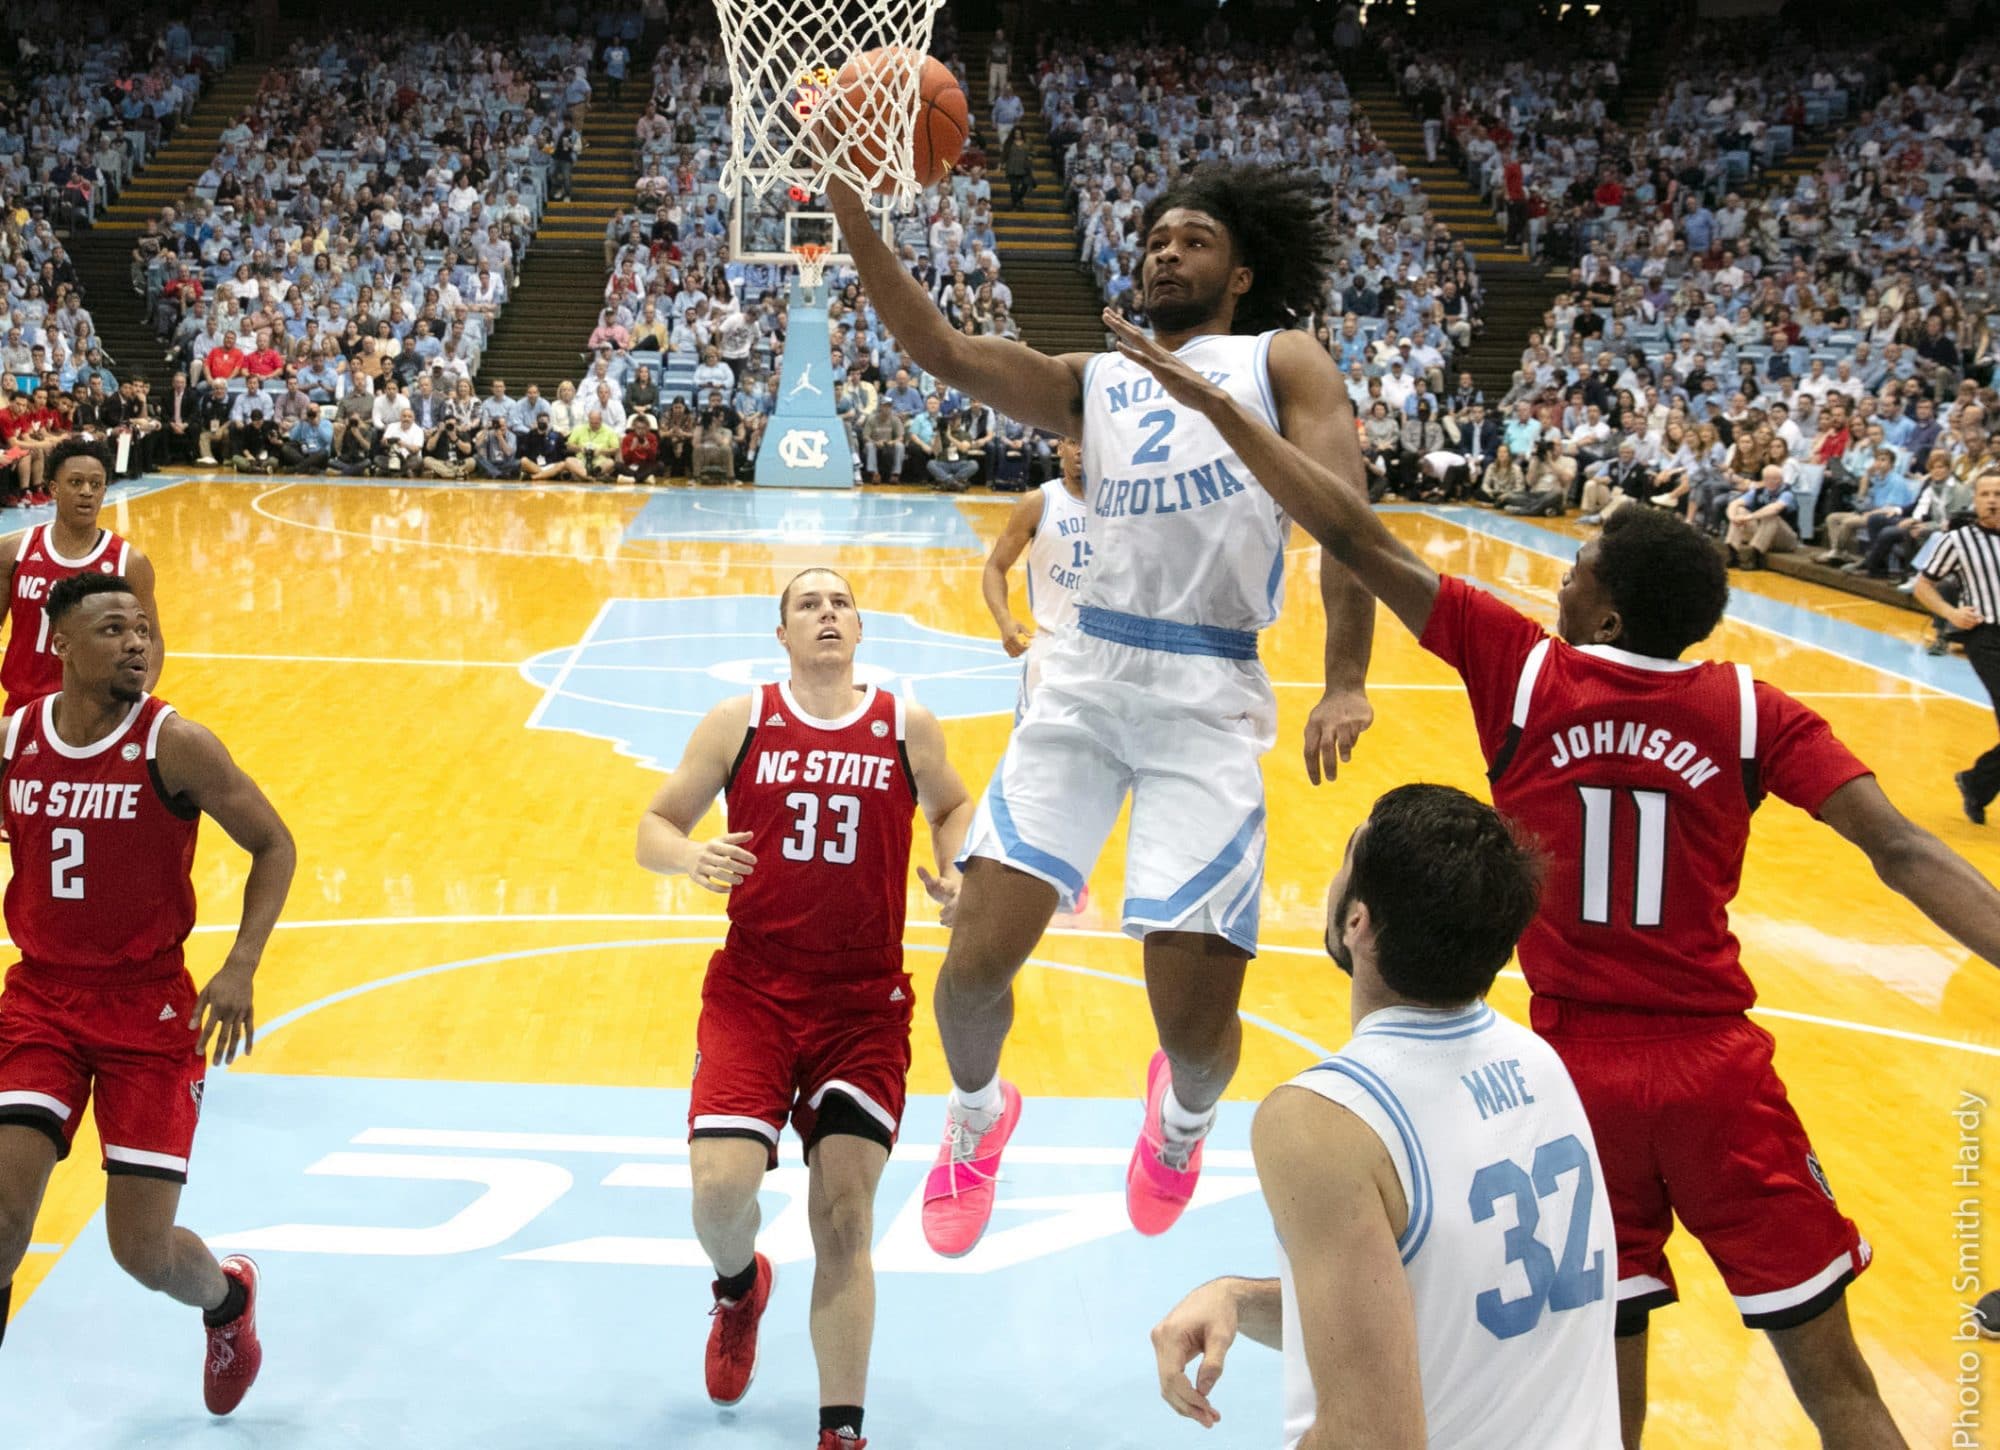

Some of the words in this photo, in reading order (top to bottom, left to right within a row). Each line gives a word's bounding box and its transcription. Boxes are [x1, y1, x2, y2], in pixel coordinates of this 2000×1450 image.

[1131, 409, 1177, 466] 2
[1095, 458, 1246, 518] CAROLINA
[18, 575, 47, 600] NC
[755, 750, 800, 785] NC
[802, 750, 896, 792] STATE
[1550, 719, 1721, 789] JOHNSON
[9, 778, 44, 816] NC
[45, 781, 143, 820] STATE
[781, 791, 862, 866] 33
[51, 826, 85, 899] 2
[1577, 785, 1668, 927] 11
[1460, 1058, 1536, 1121] MAYE
[1468, 1133, 1605, 1341] 32
